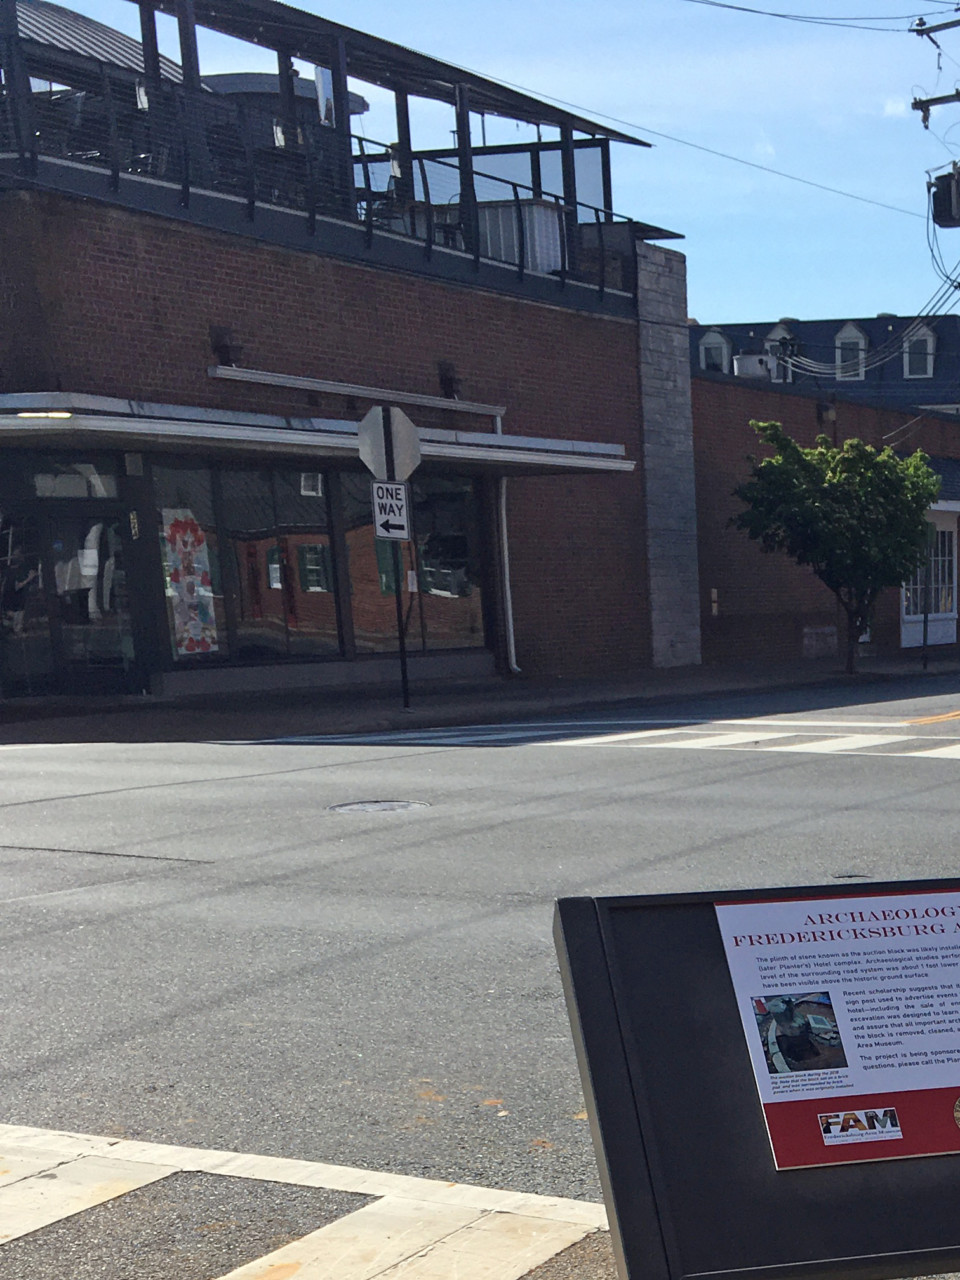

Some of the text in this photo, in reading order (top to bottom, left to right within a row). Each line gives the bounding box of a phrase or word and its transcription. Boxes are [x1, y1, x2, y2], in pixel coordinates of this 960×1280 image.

[376, 485, 403, 502] ONE
[377, 502, 404, 517] WAY
[732, 923, 945, 947] FREDERICKSBURG
[769, 955, 788, 963] plinth
[865, 956, 913, 965] Archaeological
[800, 969, 840, 978] surrounding
[859, 966, 883, 974] system
[868, 987, 906, 995] scholarship
[908, 984, 938, 993] suggests
[861, 997, 875, 1005] post
[849, 1014, 884, 1022] excavation
[902, 1011, 931, 1019] designed
[914, 1019, 946, 1027] important
[874, 1053, 898, 1061] project
[909, 1050, 928, 1058] being
[897, 1060, 919, 1068] please
[820, 1109, 897, 1133] FAM
